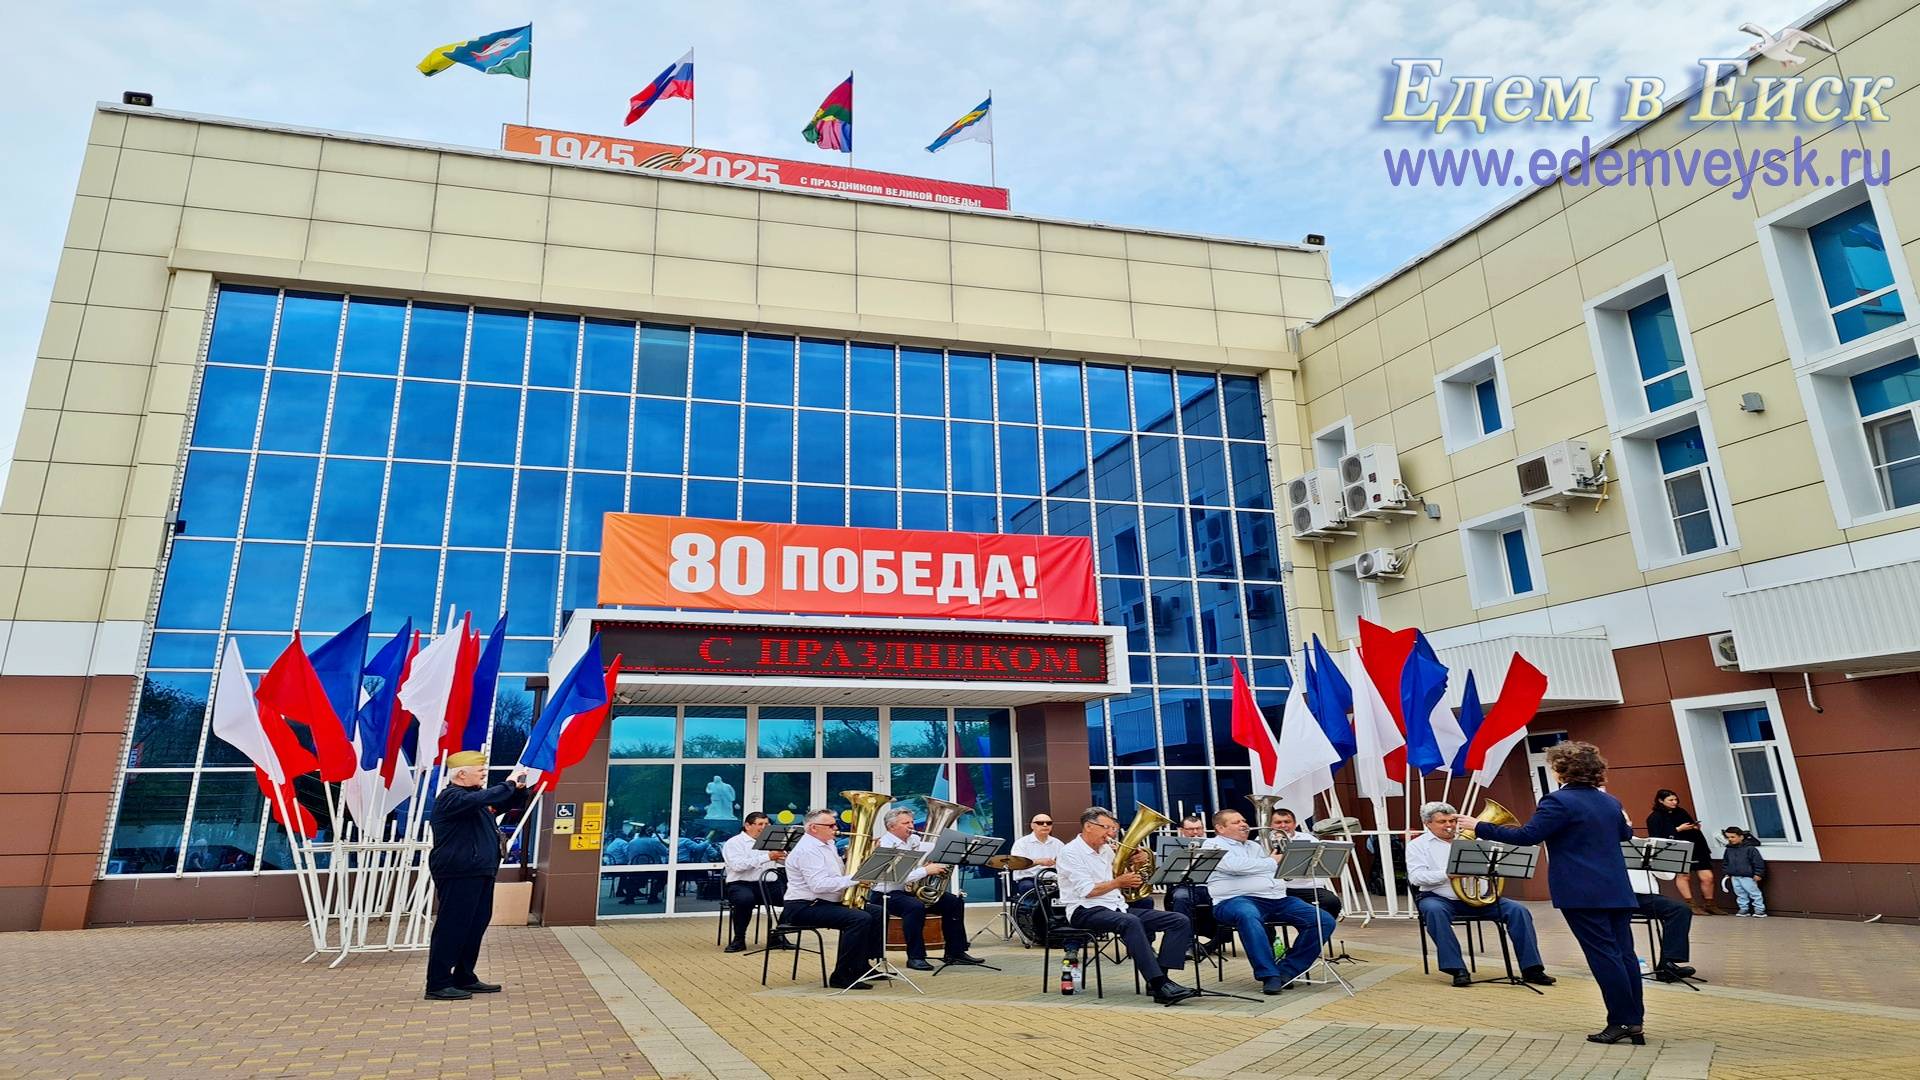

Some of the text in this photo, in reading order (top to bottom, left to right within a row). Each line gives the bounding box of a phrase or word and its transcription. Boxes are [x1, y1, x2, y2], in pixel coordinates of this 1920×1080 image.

[534, 134, 781, 186] 1945 2025
[800, 176, 982, 208] С ПРАЗДНИКОМ ВЕЛИКОЙ ПОБЕДЫ!
[669, 532, 1039, 605] 80 ПОБЕДА!
[699, 637, 1083, 674] С ПРАЗДНИКОМ
